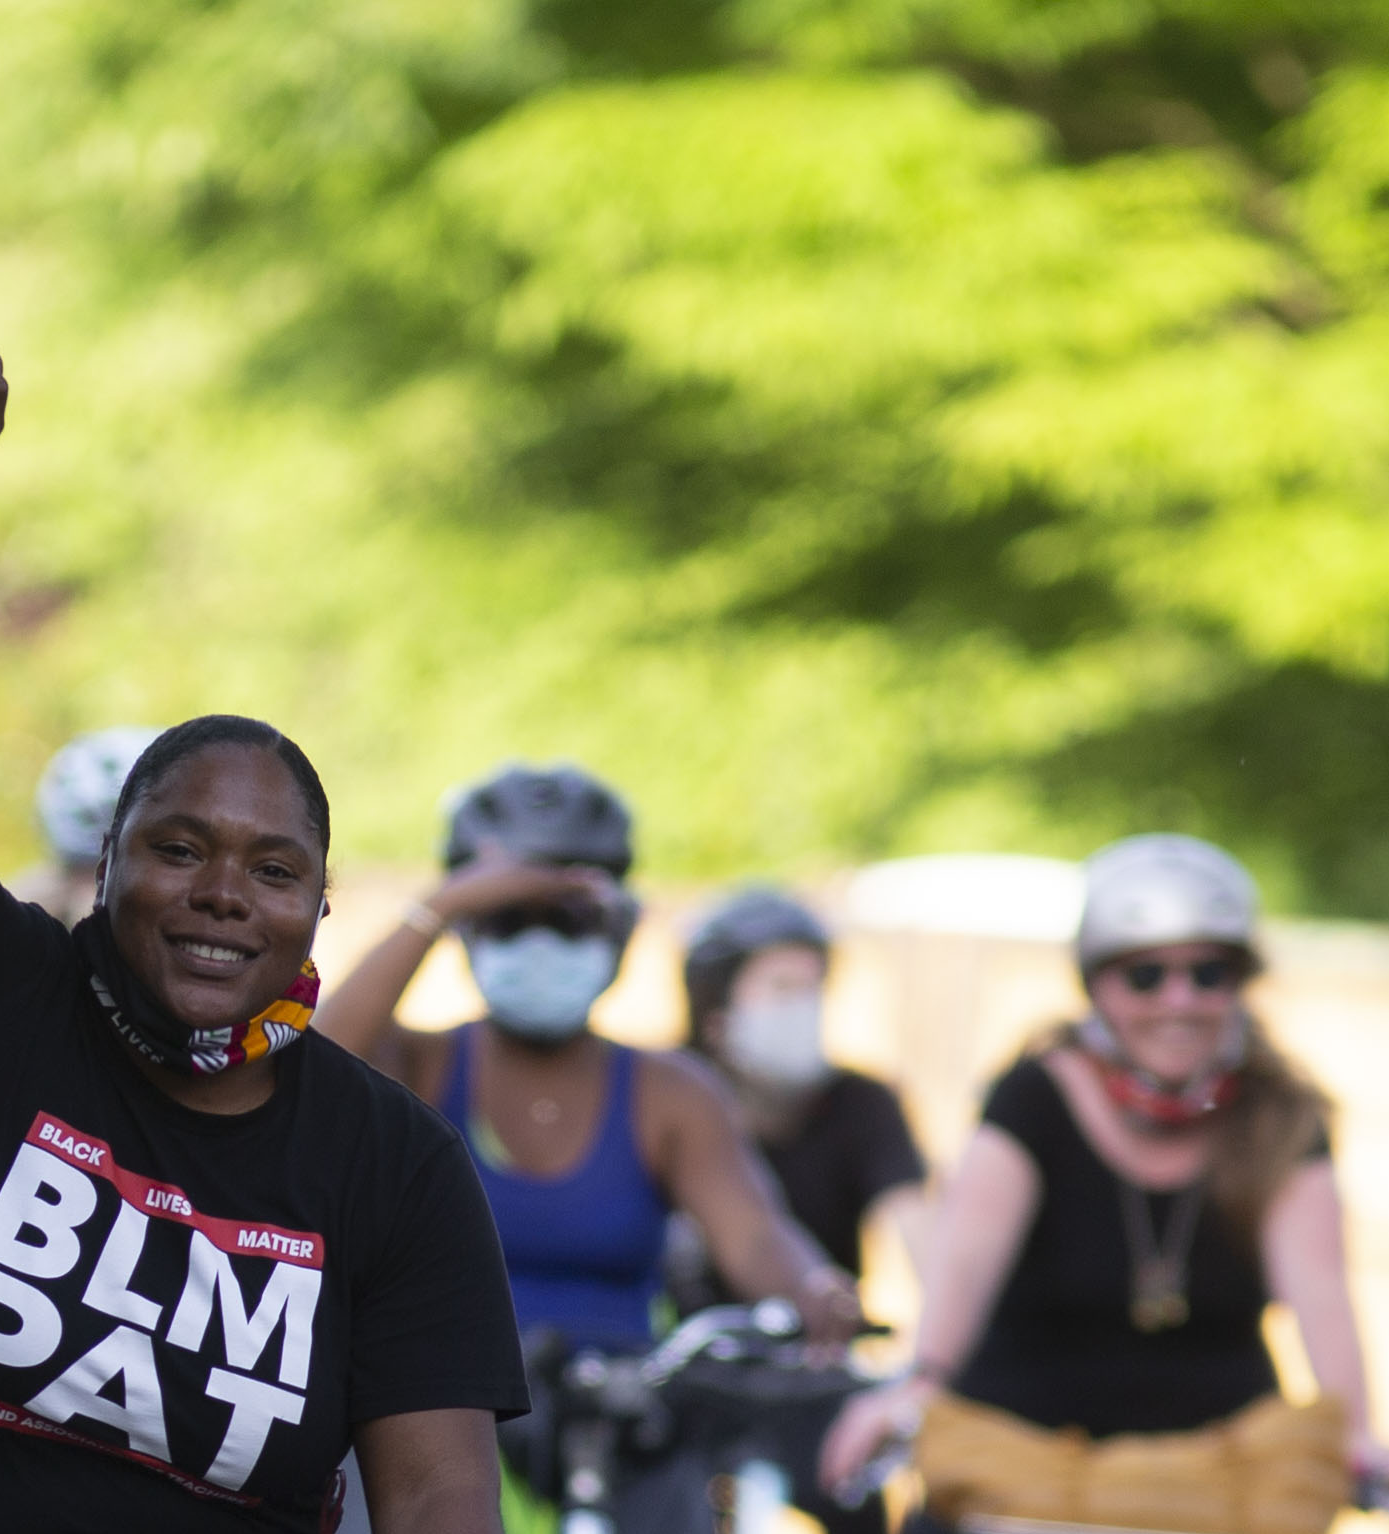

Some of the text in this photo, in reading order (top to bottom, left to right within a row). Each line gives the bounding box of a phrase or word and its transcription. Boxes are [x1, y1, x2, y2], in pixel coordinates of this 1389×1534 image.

[38, 1122, 315, 1258] BLACK LIVES MATTER
